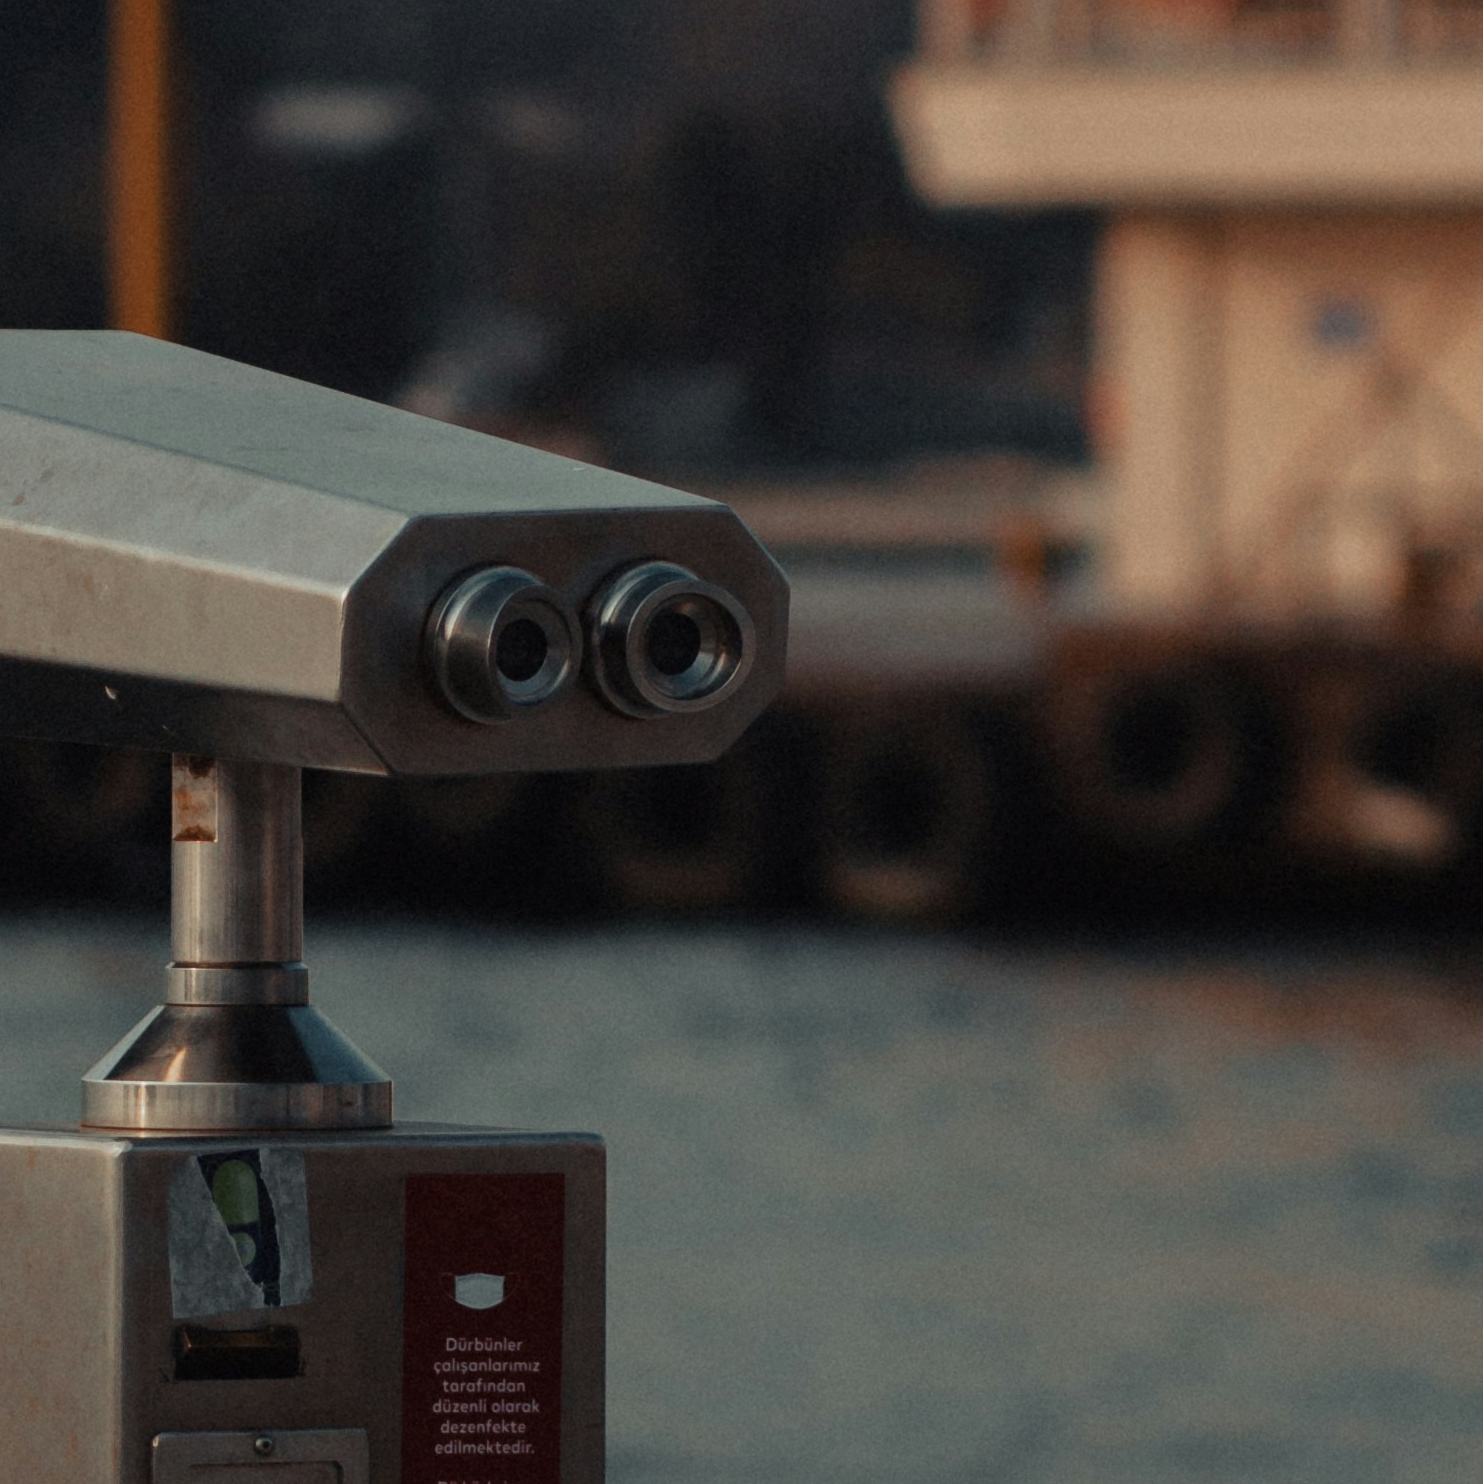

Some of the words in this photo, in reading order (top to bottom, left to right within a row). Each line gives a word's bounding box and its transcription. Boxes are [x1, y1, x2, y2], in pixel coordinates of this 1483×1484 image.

[445, 1337, 523, 1352] Dürbünler
[433, 1358, 541, 1375] çalışanlarımız
[442, 1378, 525, 1393] tarafından
[432, 1399, 487, 1413] düzenli
[491, 1399, 540, 1413] olarak
[440, 1419, 526, 1434] dezenfekte
[434, 1440, 535, 1455] edilmektedir.
